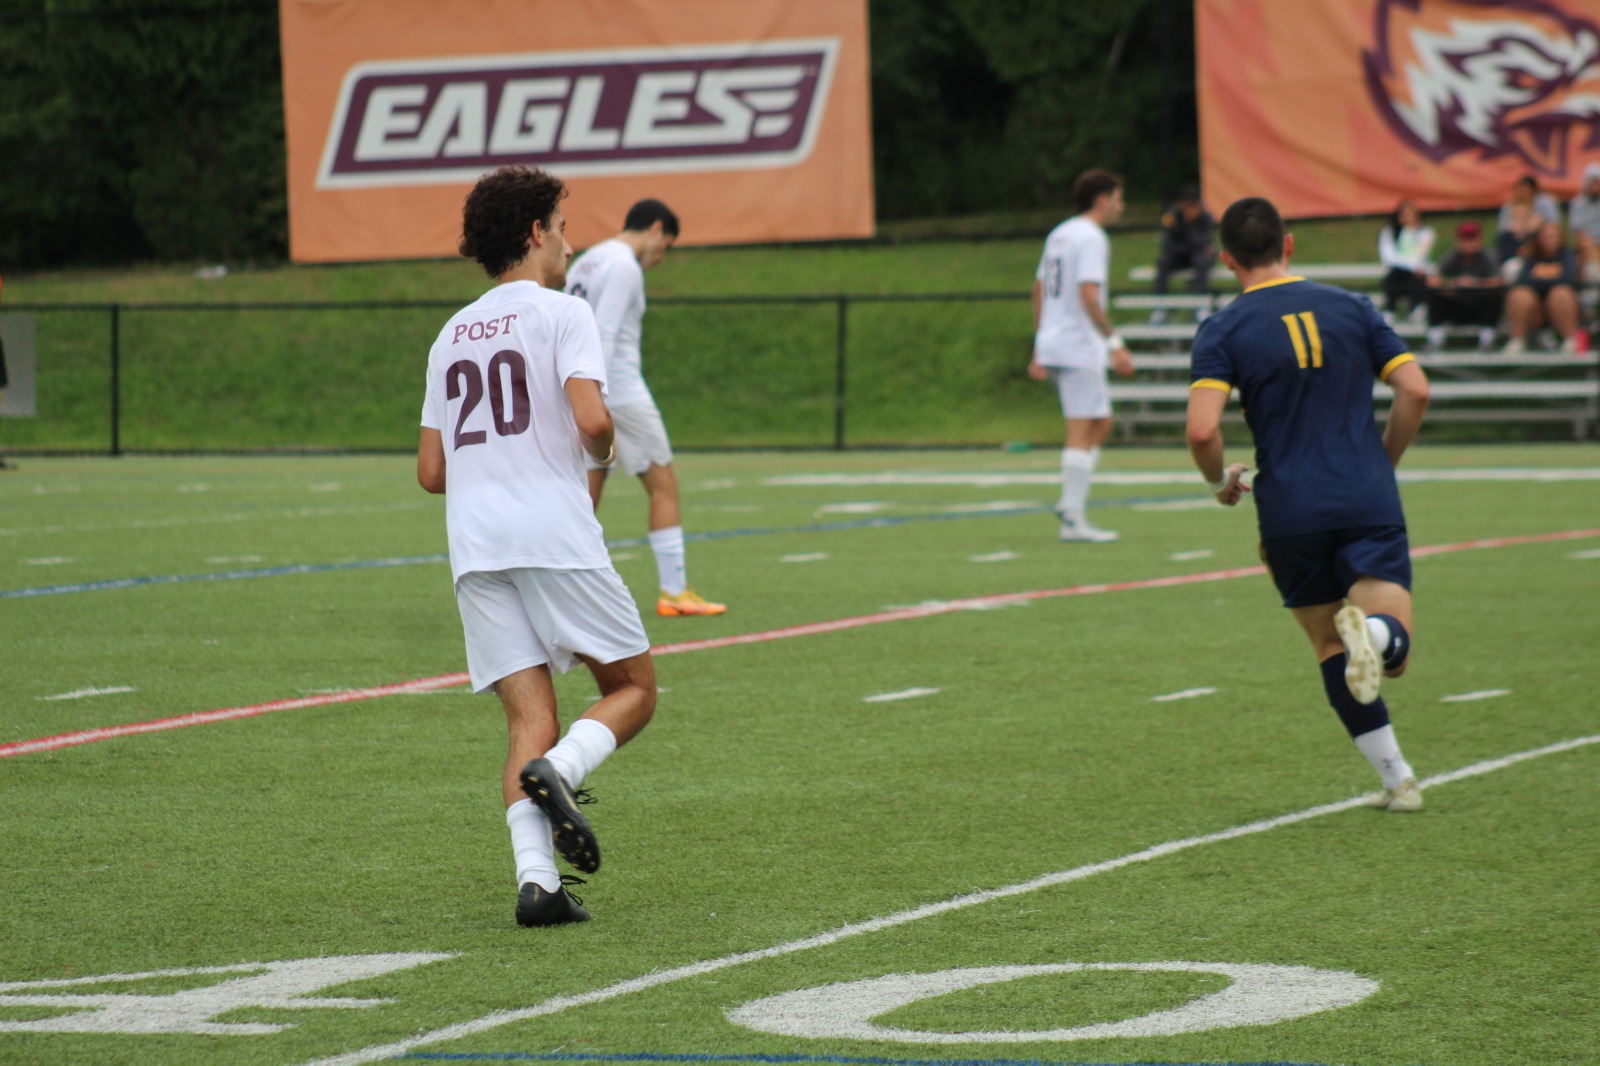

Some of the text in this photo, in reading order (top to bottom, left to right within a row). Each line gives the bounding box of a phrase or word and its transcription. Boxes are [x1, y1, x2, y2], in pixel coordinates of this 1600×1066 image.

[353, 65, 806, 161] EAGLES
[452, 314, 518, 345] POST
[1281, 311, 1323, 368] 11
[446, 349, 531, 452] 20
